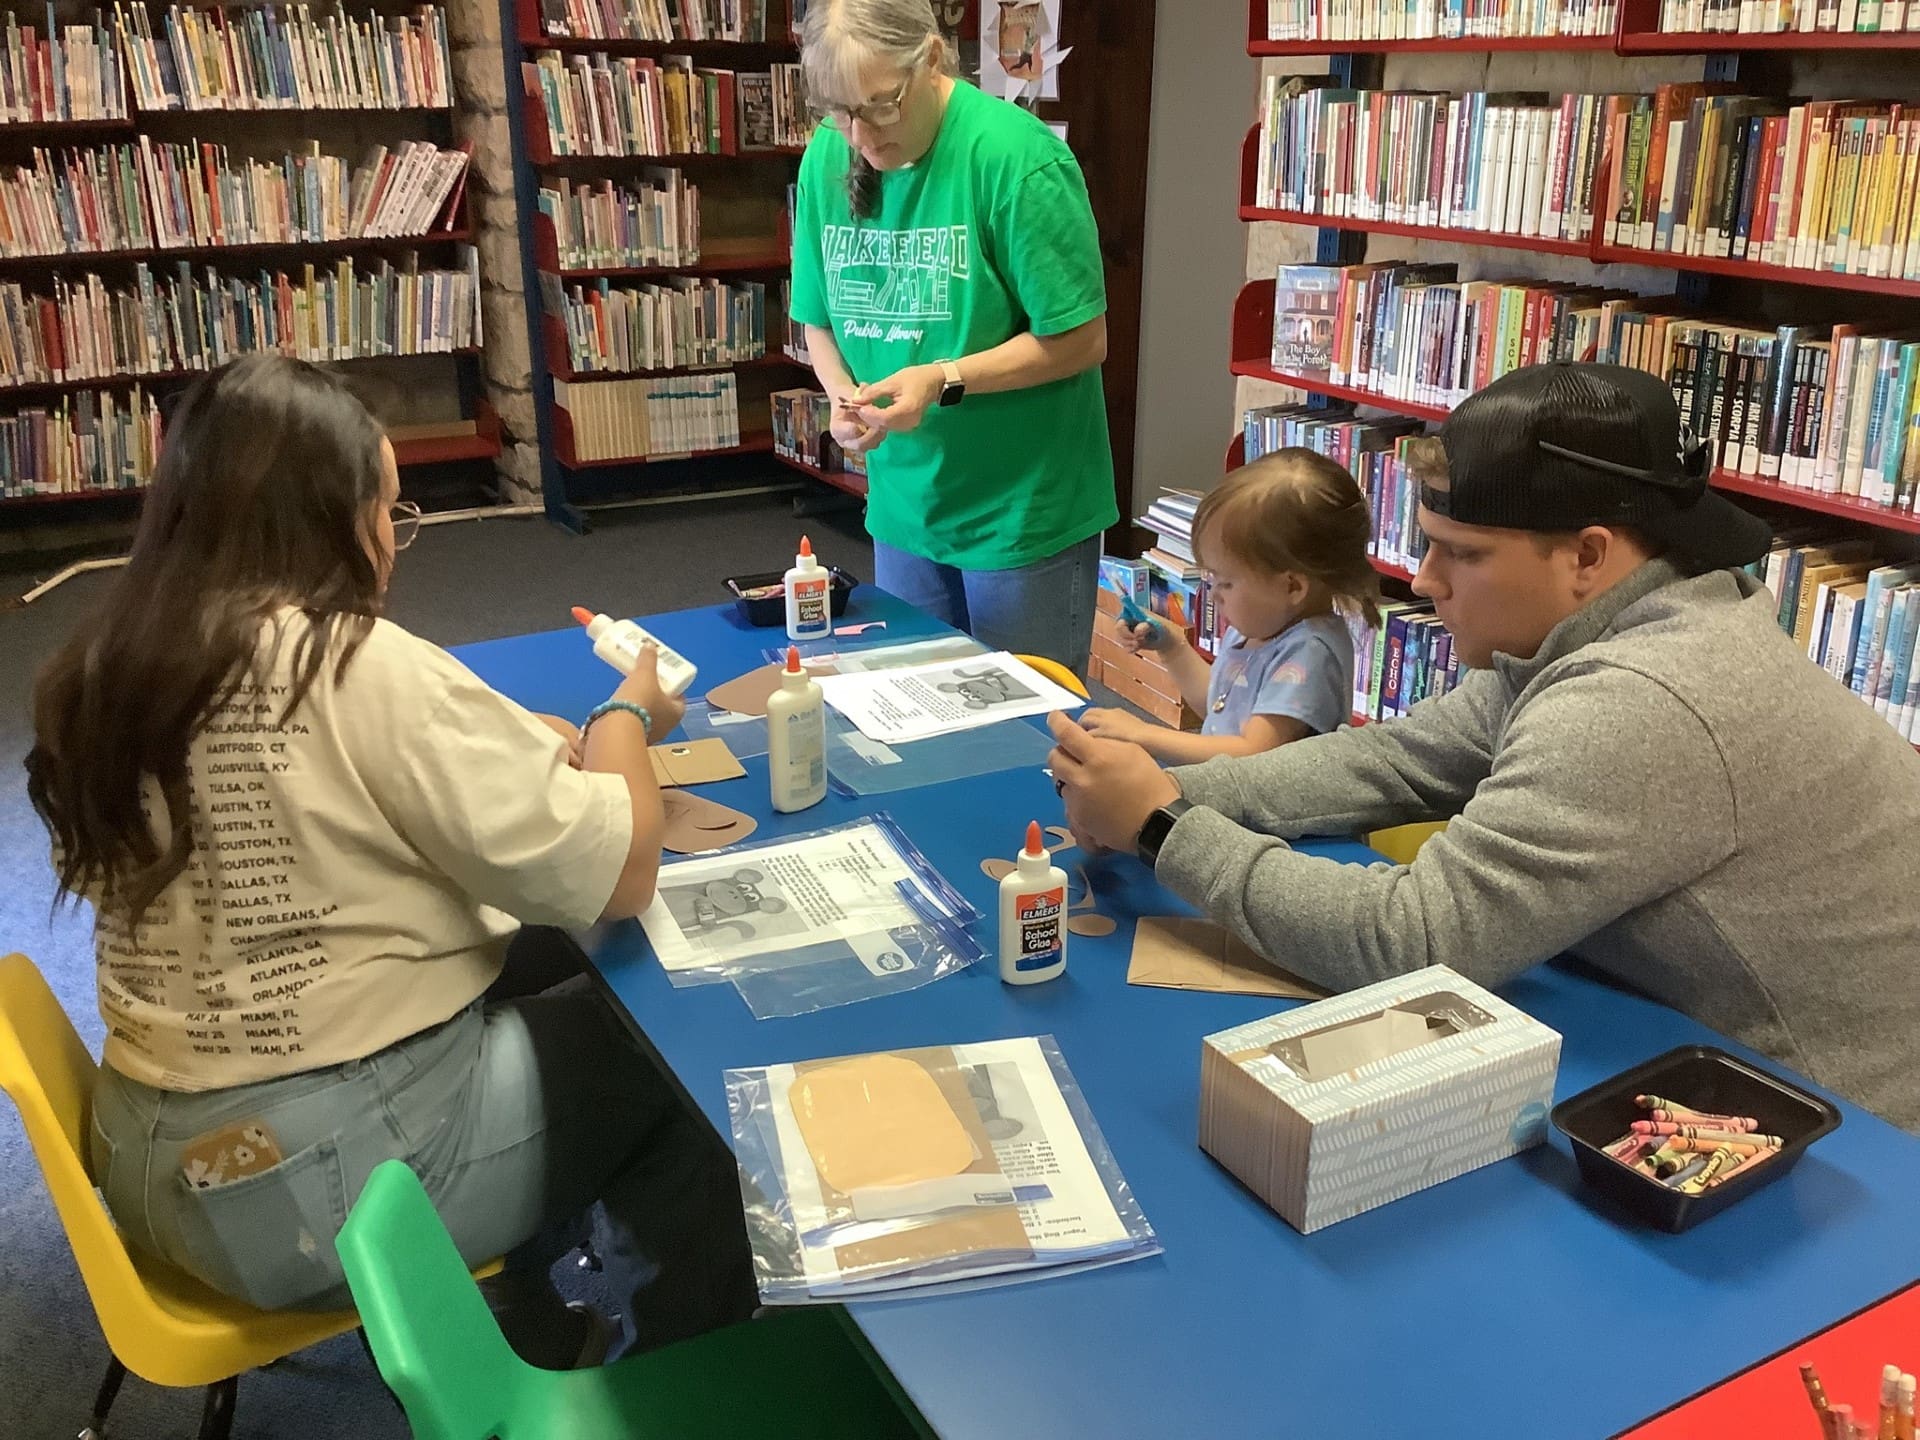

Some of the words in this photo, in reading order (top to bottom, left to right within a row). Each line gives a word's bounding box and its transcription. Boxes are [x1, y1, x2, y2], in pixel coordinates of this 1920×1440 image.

[823, 225, 970, 280] AKEFELD
[844, 320, 883, 339] Public
[884, 324, 923, 344] Library
[1290, 344, 1303, 354] The
[1304, 345, 1320, 356] Boy
[1507, 338, 1516, 372] SCA
[1711, 395, 1724, 418] EAGLE
[1746, 402, 1761, 423] ARK
[1728, 398, 1744, 441] SCORPIA
[1744, 423, 1758, 446] ANGE
[1374, 640, 1384, 662] ROOT
[271, 686, 288, 695] NY
[205, 723, 288, 735] PHILADELPHIA,
[292, 725, 309, 735] PA
[206, 743, 267, 755] HARTFORD,
[270, 743, 286, 753] CT
[208, 762, 269, 775] LOUISVILLE,
[272, 763, 289, 772] KY
[209, 782, 245, 794] TULSA,
[247, 782, 265, 791] OK
[210, 802, 253, 813] AUSTIN,
[256, 800, 271, 810] TX
[213, 821, 256, 832] AUSTIN,
[259, 819, 274, 829] TX
[278, 837, 292, 846] TX
[281, 856, 296, 865] TX
[221, 876, 270, 890] DALLAS,
[272, 874, 288, 884] TX
[222, 895, 273, 909] DALLAS,
[275, 893, 291, 903] TX
[226, 917, 253, 928] NEW
[257, 908, 320, 925] ORLEANS,
[322, 904, 338, 916] LA
[1022, 904, 1060, 919] ELMER'S
[1025, 924, 1057, 941] School
[246, 944, 303, 965] ATLANTA,
[304, 939, 322, 951] GA
[1028, 939, 1051, 951] Glue
[250, 962, 307, 984] ATLANTA,
[308, 956, 328, 969] GA
[185, 1013, 206, 1021] MAY
[208, 1013, 220, 1023] 24
[240, 1011, 281, 1023] MIAMI,
[283, 1009, 299, 1019] FL
[246, 1028, 284, 1039] MIAMI,
[286, 1026, 302, 1037] FL
[250, 1044, 287, 1056] MIAMI,
[289, 1043, 304, 1054] FL
